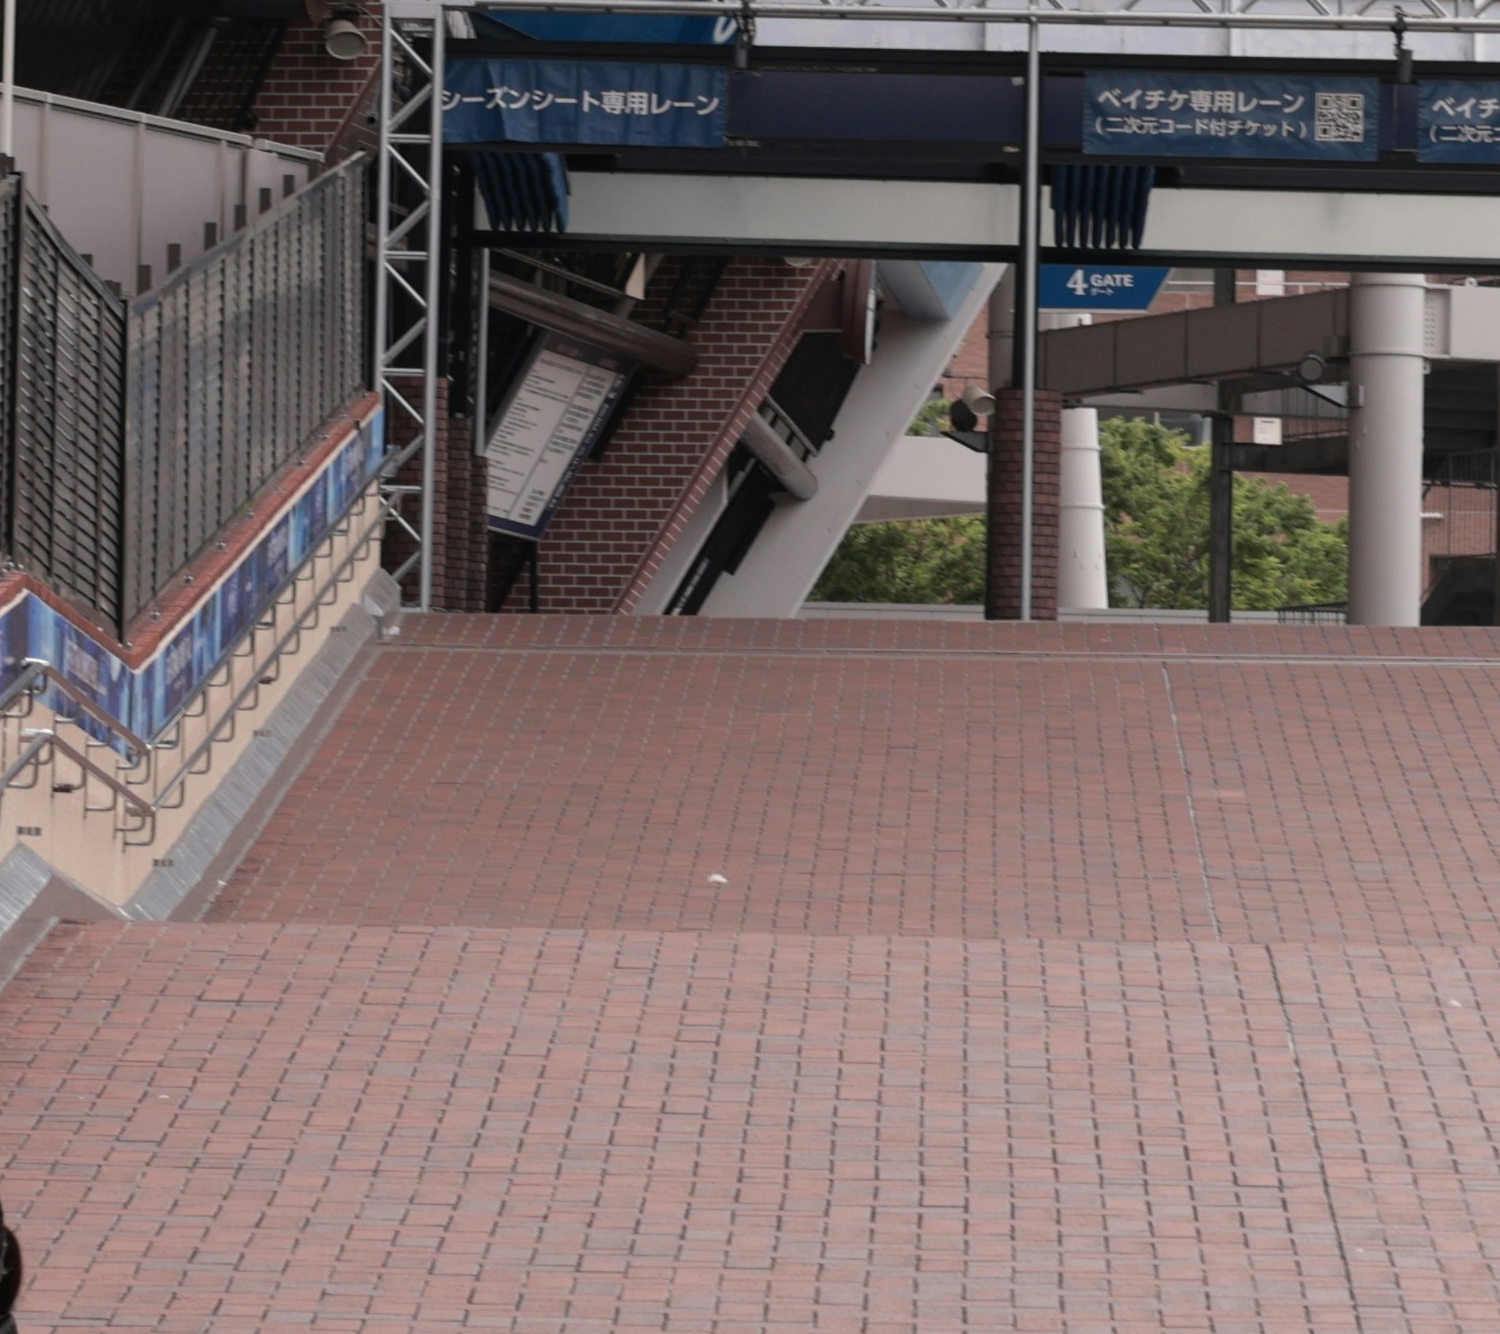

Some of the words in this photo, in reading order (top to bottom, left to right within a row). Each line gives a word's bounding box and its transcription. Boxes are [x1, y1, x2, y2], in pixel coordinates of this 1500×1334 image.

[441, 85, 721, 116] シーズンシート専用レーン
[1096, 86, 1305, 114] ベイチケ専用レーン
[1066, 268, 1089, 296] 4
[1090, 273, 1135, 288] GATE
